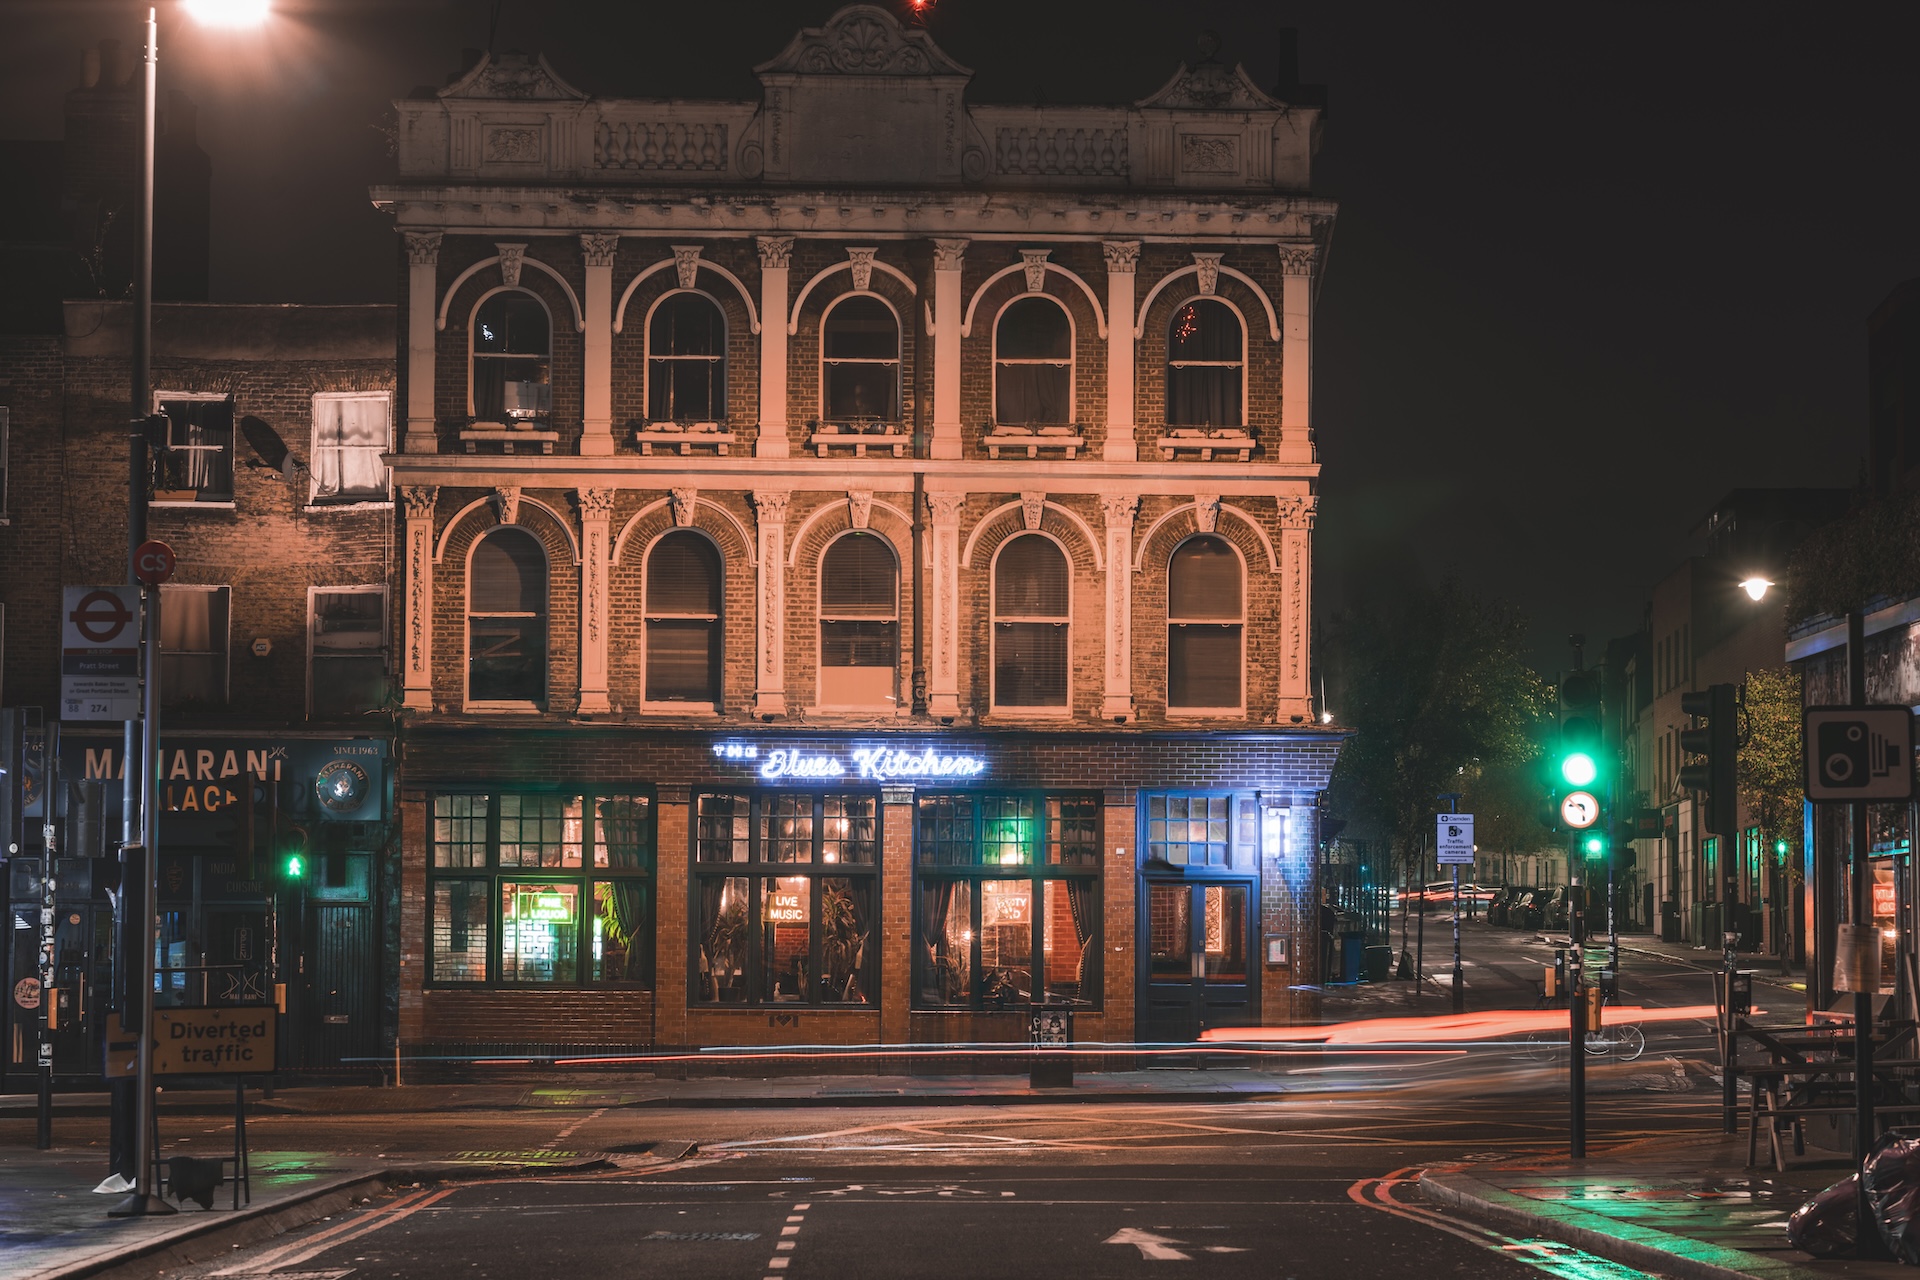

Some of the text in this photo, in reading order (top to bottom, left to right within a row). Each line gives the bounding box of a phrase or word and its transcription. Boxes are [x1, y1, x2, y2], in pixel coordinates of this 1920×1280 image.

[139, 553, 167, 572] CS
[68, 704, 107, 712] 88 274
[333, 746, 379, 755] SINCE 1963
[322, 762, 366, 781] MAHARANI
[713, 744, 986, 781] THE Blues Kitchen
[775, 895, 799, 907] LIVE
[531, 909, 568, 919] LIQUOR
[770, 908, 803, 921] MUSIC
[239, 929, 248, 959] OPEN
[169, 1020, 267, 1039] Diverted
[182, 1043, 255, 1063] traffic
